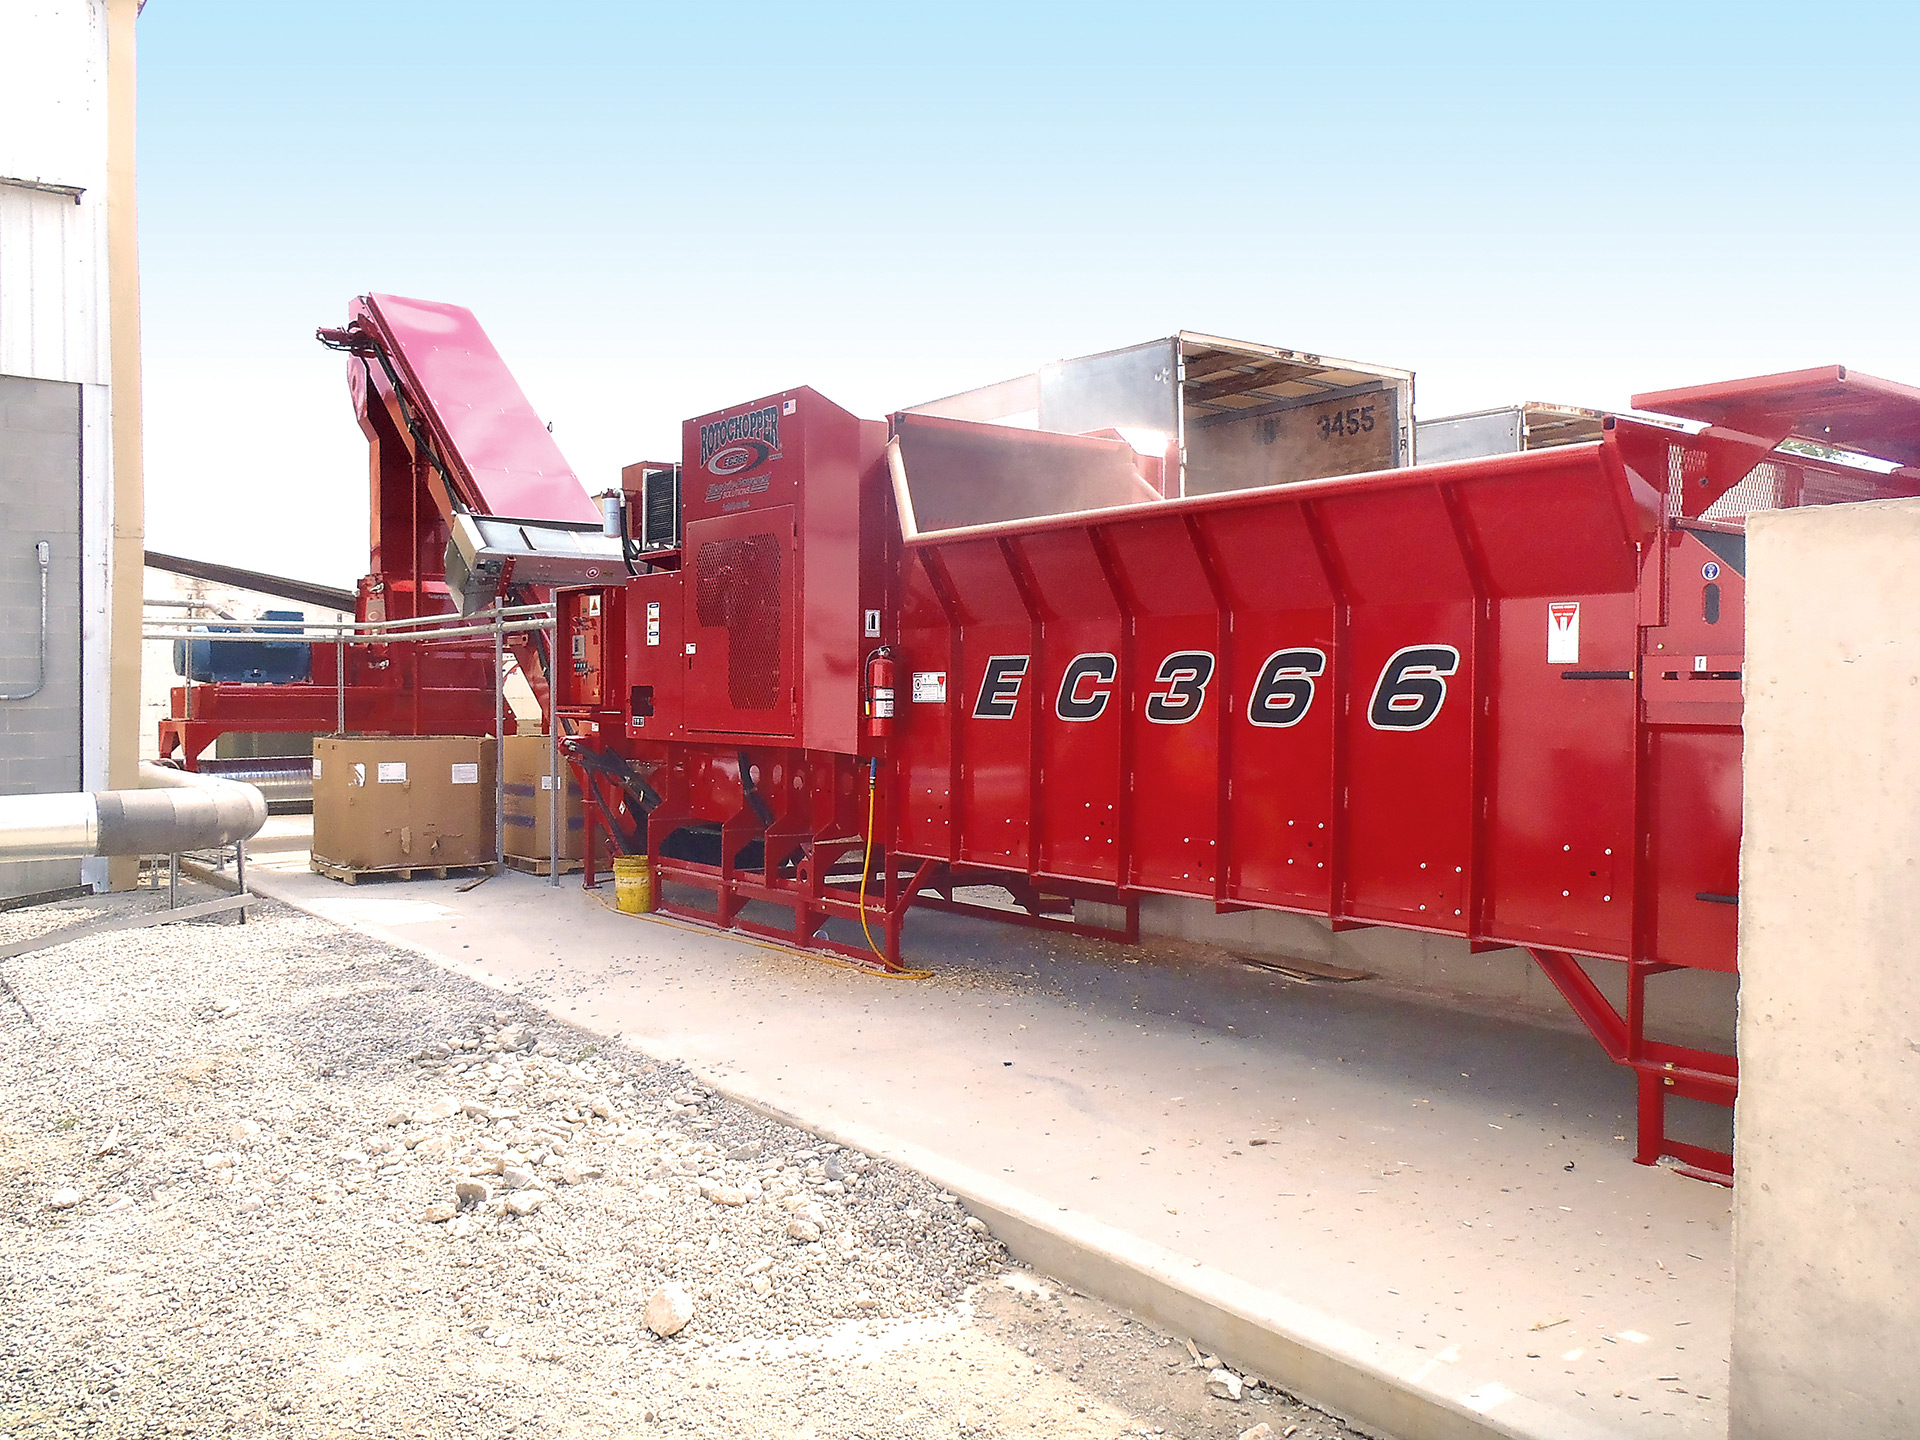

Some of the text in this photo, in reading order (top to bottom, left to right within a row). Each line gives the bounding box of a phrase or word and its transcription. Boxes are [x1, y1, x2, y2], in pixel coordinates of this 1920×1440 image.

[700, 405, 778, 468] ROTOCHOPPER
[1316, 405, 1375, 440] 3455
[723, 453, 748, 467] EC366
